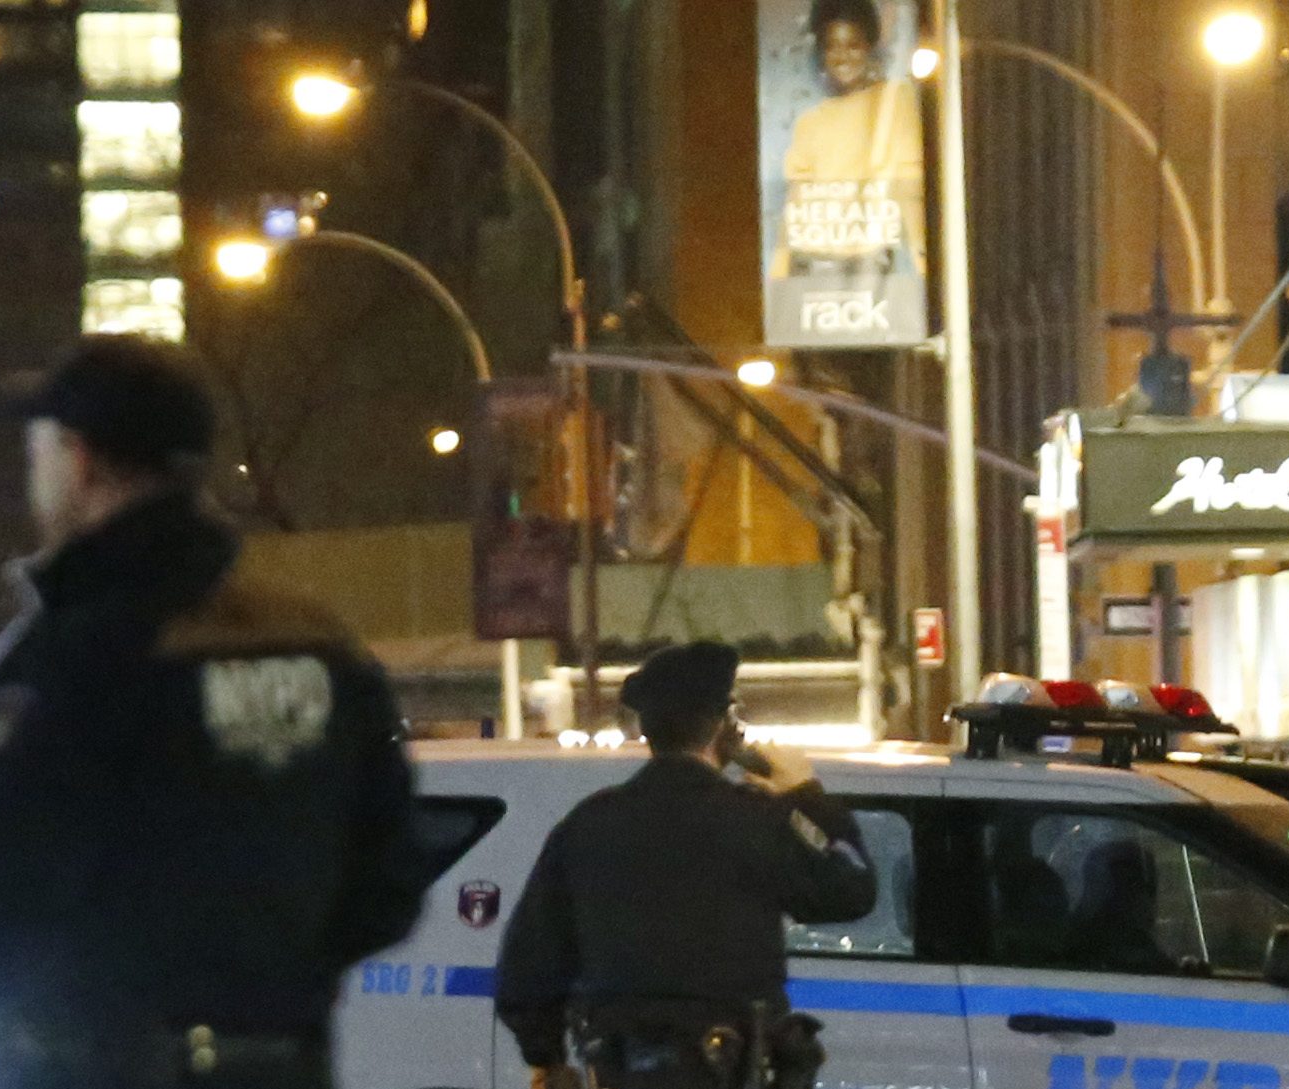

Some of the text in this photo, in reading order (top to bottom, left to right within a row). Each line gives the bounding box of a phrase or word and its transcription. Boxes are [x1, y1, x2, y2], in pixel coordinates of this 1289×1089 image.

[786, 200, 901, 224] HERALD
[787, 223, 901, 247] SQUARE
[799, 291, 891, 332] rack
